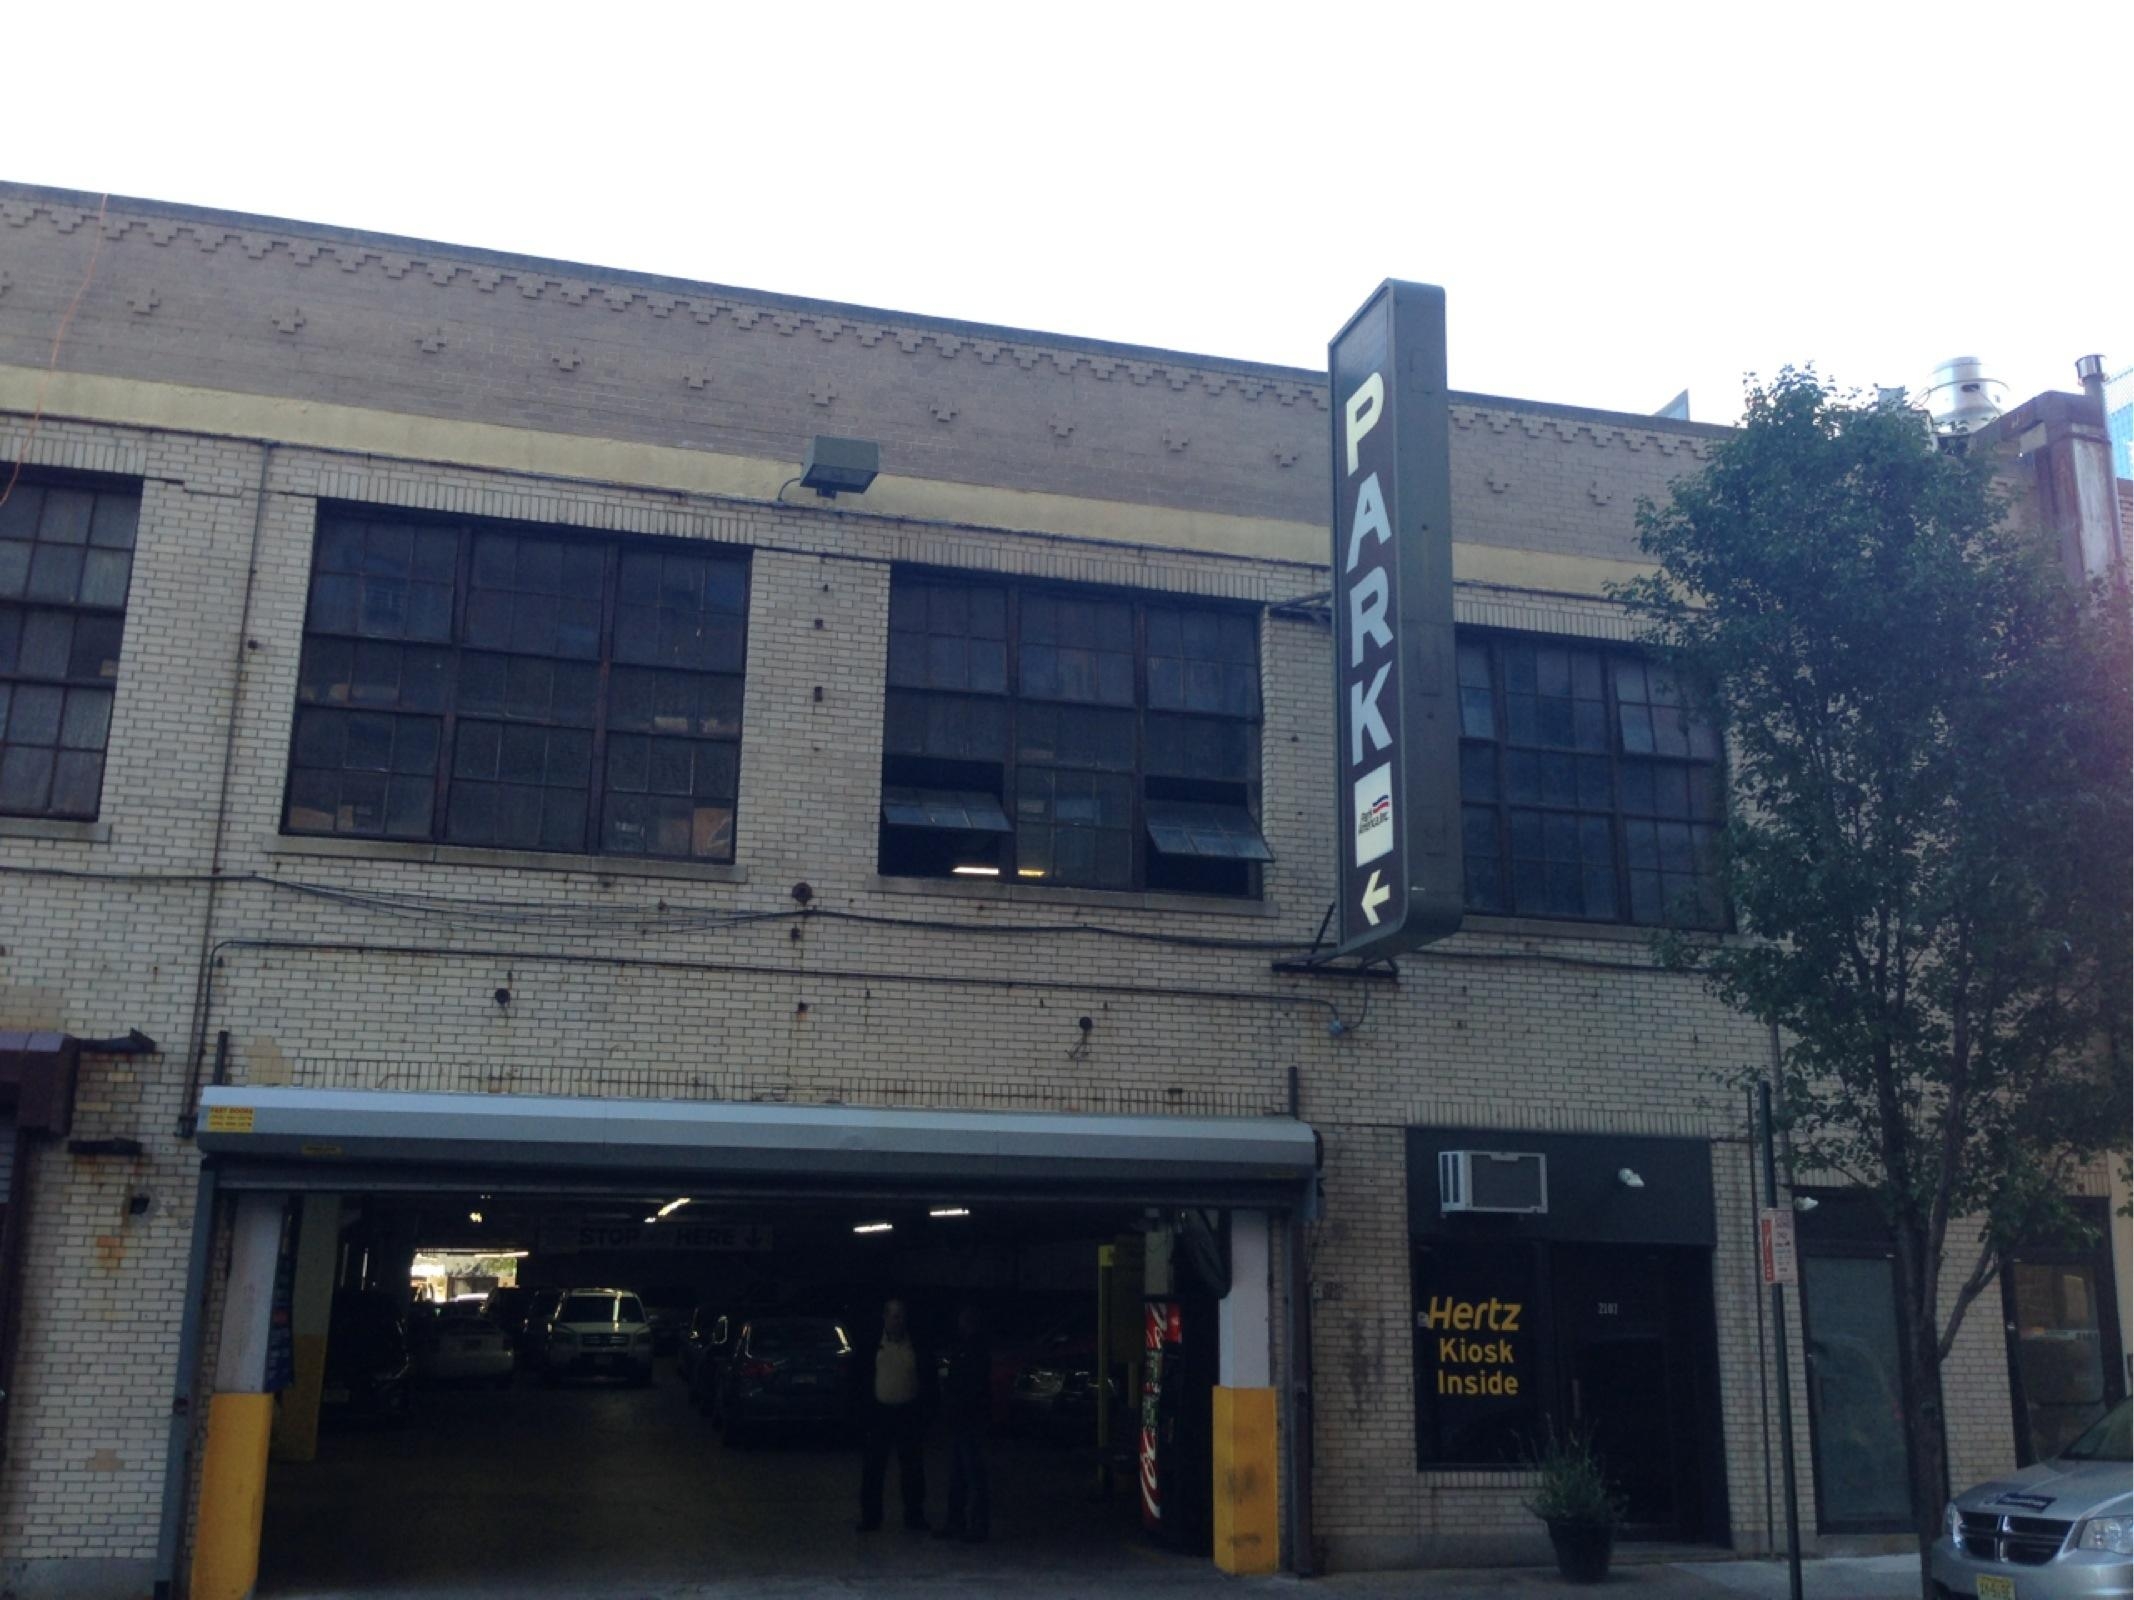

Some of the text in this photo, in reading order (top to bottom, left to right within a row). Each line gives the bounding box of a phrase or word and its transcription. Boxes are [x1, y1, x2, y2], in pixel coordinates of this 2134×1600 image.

[1346, 372, 1393, 767] PARK
[578, 1227, 641, 1246] STOP
[677, 1227, 736, 1246] HERE
[1427, 1296, 1522, 1331] Hertz
[1440, 1338, 1514, 1363] Kiosk
[1438, 1369, 1519, 1395] Inside
